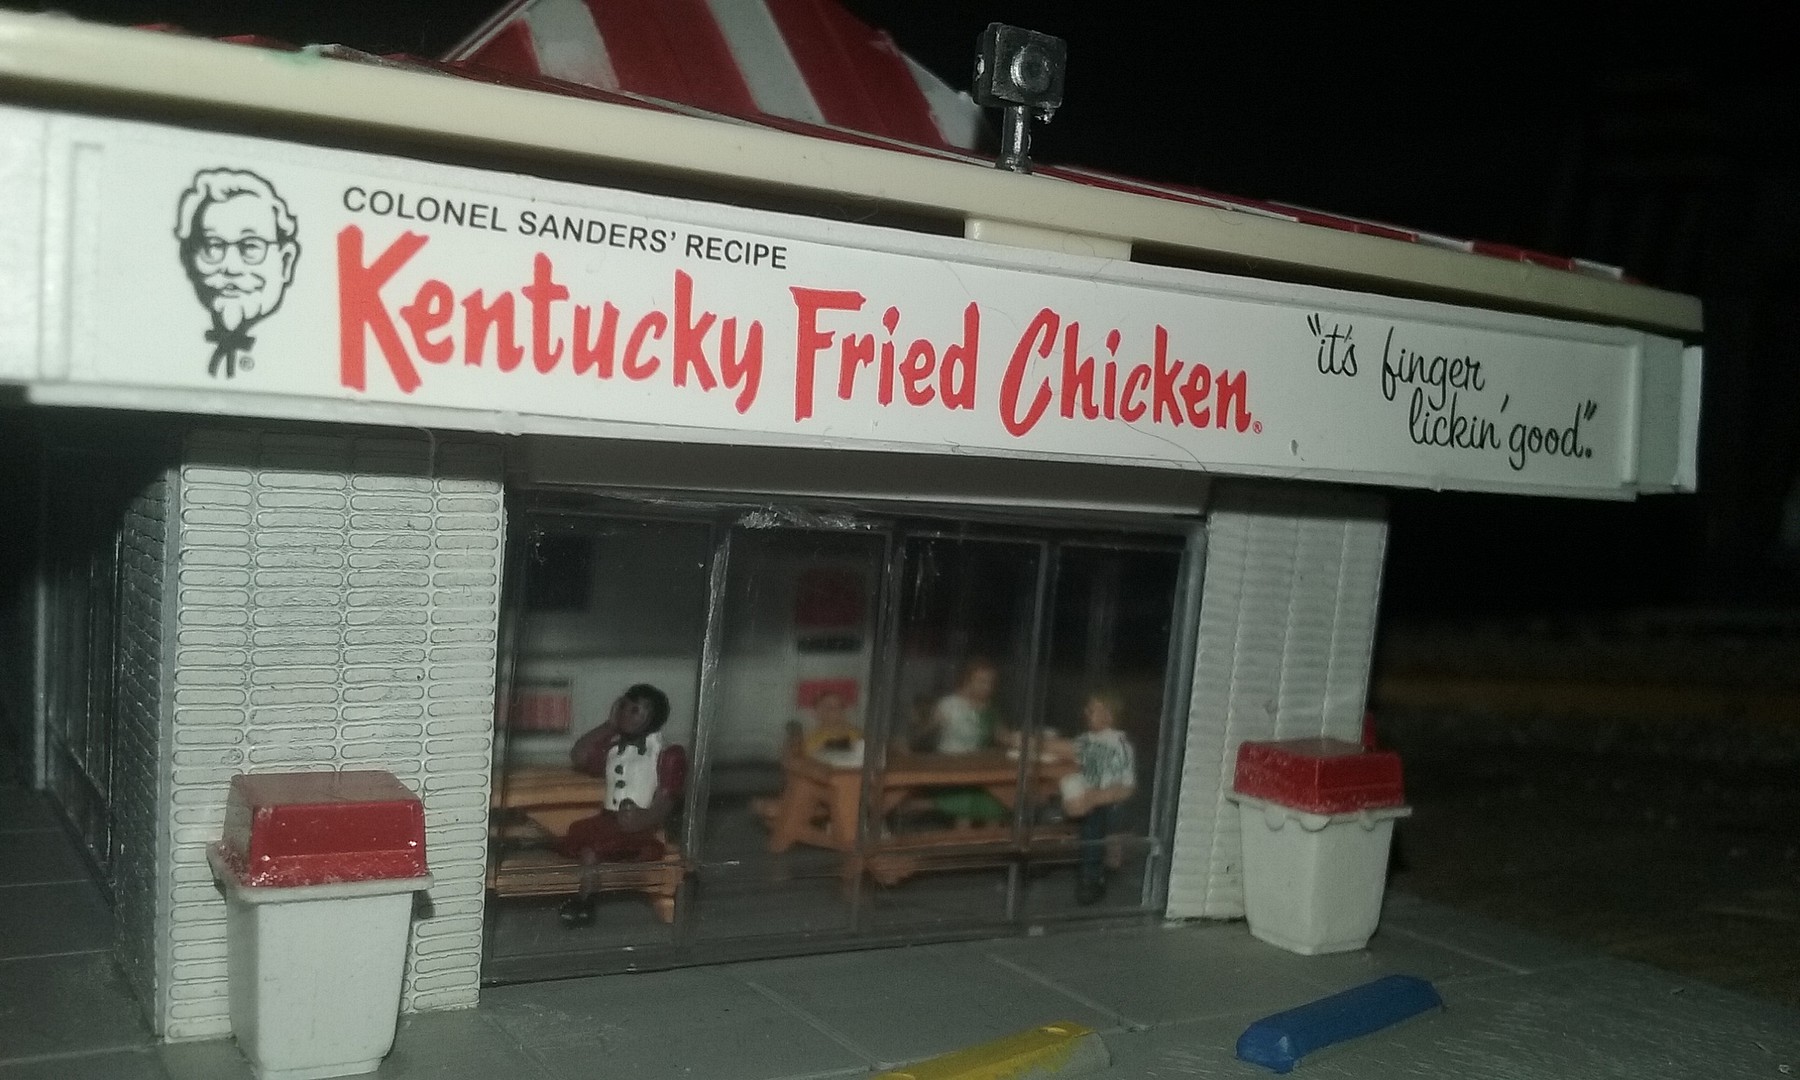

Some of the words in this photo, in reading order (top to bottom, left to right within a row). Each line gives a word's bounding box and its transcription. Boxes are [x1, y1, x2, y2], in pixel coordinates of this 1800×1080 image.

[342, 186, 508, 233] COLONEL
[517, 210, 676, 255] SANDERS'
[685, 233, 788, 270] RECIPE
[337, 225, 763, 414] Kentucky
[790, 286, 980, 421] Fried
[1381, 325, 1486, 412] finger
[1408, 386, 1510, 451] lickin'
